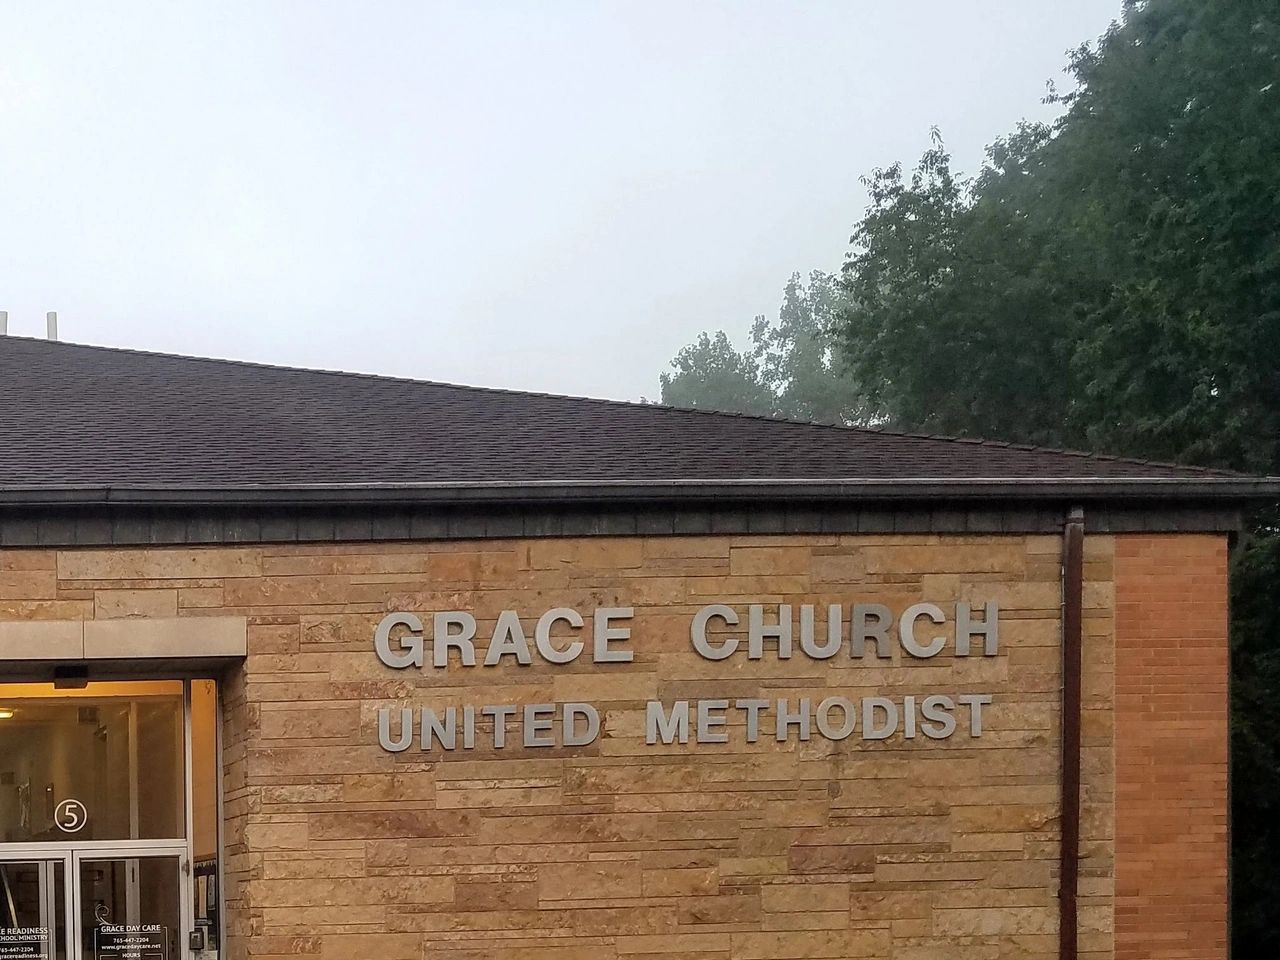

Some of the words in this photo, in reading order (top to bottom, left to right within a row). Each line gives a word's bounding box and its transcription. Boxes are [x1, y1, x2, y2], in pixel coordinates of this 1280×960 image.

[374, 606, 635, 669] GRACE
[690, 602, 1000, 662] CHURCH
[378, 702, 601, 753] UNITED
[645, 694, 993, 744] METHODIST
[64, 804, 78, 827] 5
[7, 927, 48, 935] READINESS
